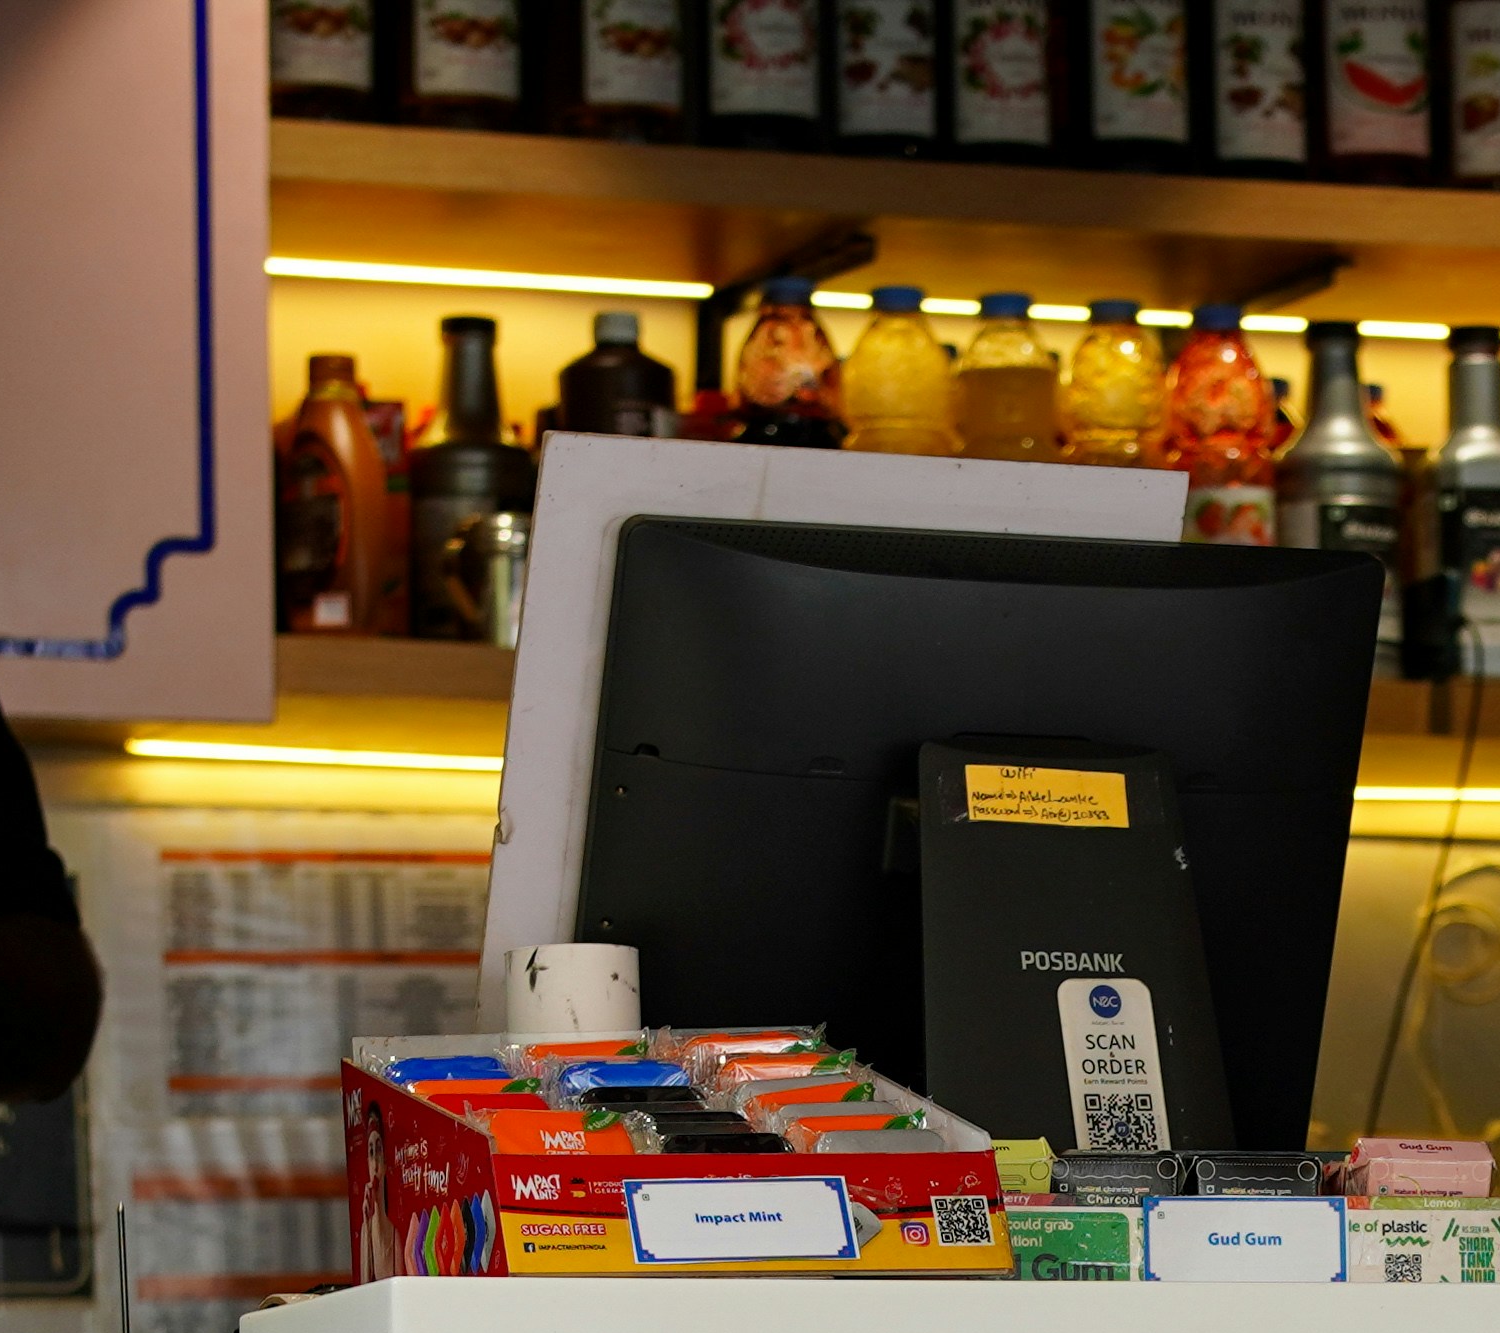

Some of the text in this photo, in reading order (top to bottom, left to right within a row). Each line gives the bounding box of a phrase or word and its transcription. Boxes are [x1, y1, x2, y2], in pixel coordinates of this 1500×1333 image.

[1021, 951, 1126, 973] POSBANK
[1086, 1034, 1135, 1050] SCAN
[1082, 1059, 1147, 1075] ORDER
[1101, 1078, 1126, 1086] Reward
[423, 1162, 450, 1195] time!
[511, 1174, 560, 1200] IMPACT
[1103, 1186, 1133, 1194] chewing
[1420, 1189, 1448, 1197] chewing
[1087, 1193, 1139, 1205] Charcoal
[1424, 1197, 1461, 1208] Lemon
[695, 1211, 783, 1226] Impact Mint
[521, 1224, 606, 1236] SUGAR FREE
[1044, 1219, 1075, 1233] grab
[1365, 1219, 1428, 1236] of plastic
[1208, 1232, 1282, 1246] Gud Gum
[1459, 1237, 1495, 1251] SHARK
[1459, 1252, 1495, 1269] TANK
